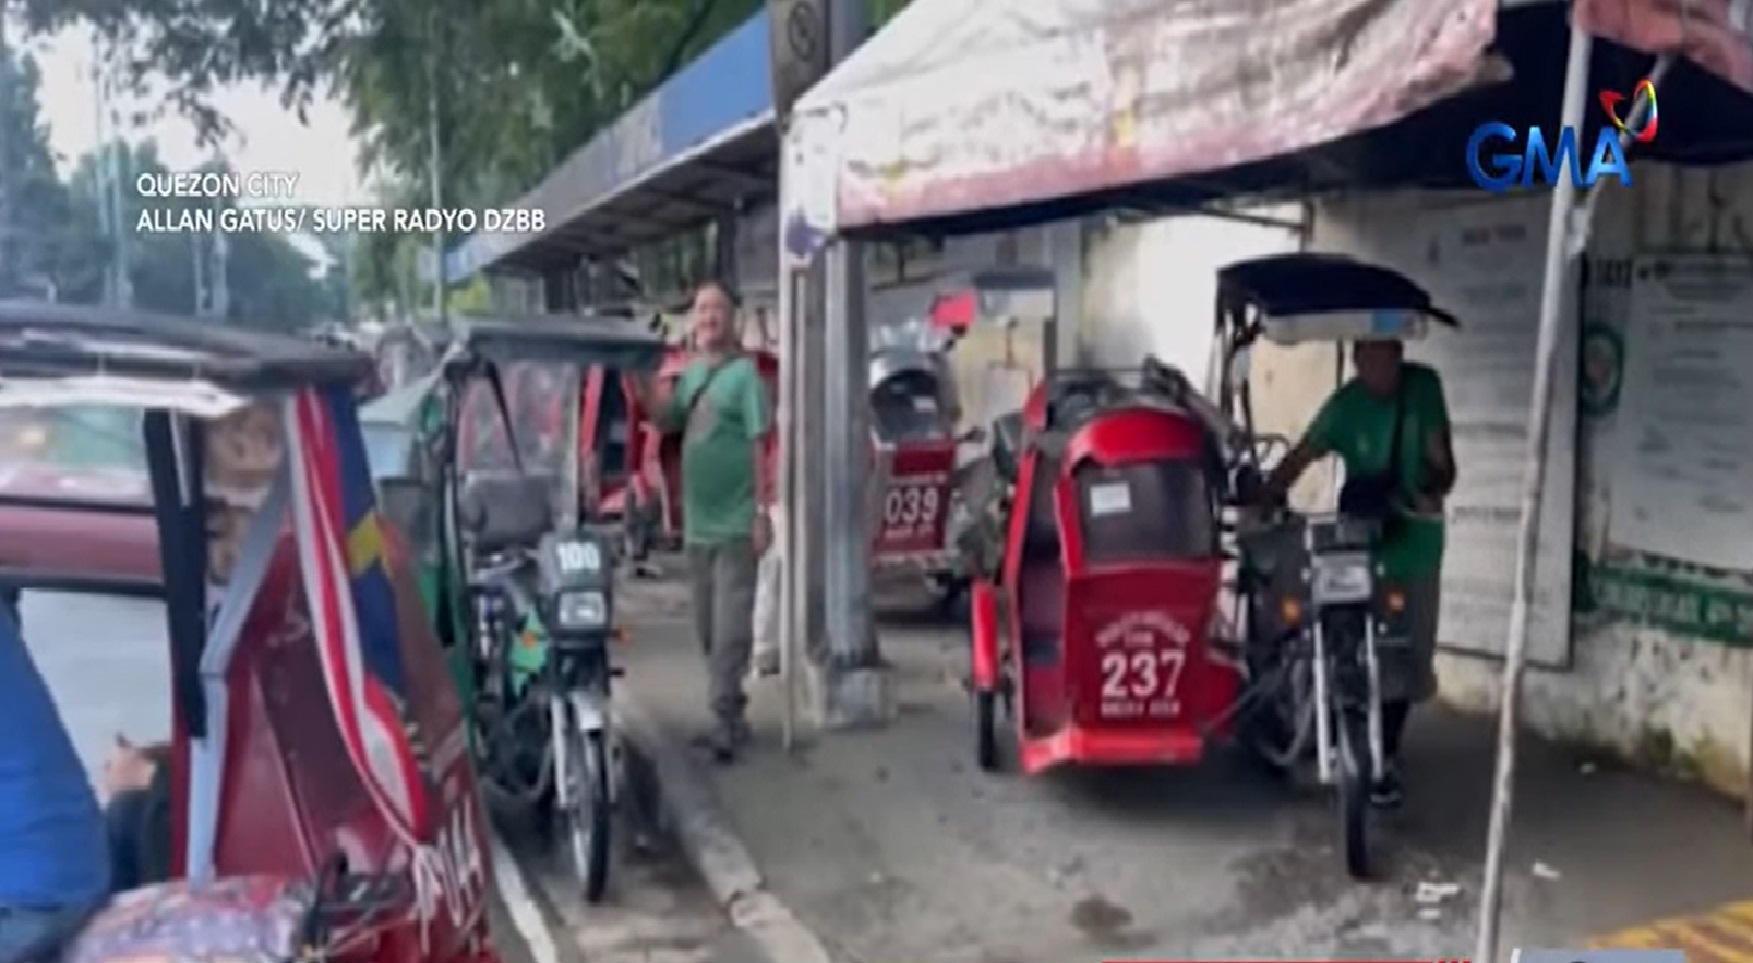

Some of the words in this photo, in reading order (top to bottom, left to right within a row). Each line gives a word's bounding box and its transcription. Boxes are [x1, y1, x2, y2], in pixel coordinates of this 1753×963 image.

[885, 488, 939, 523] 039
[556, 542, 600, 570] 100
[1102, 650, 1185, 697] 237
